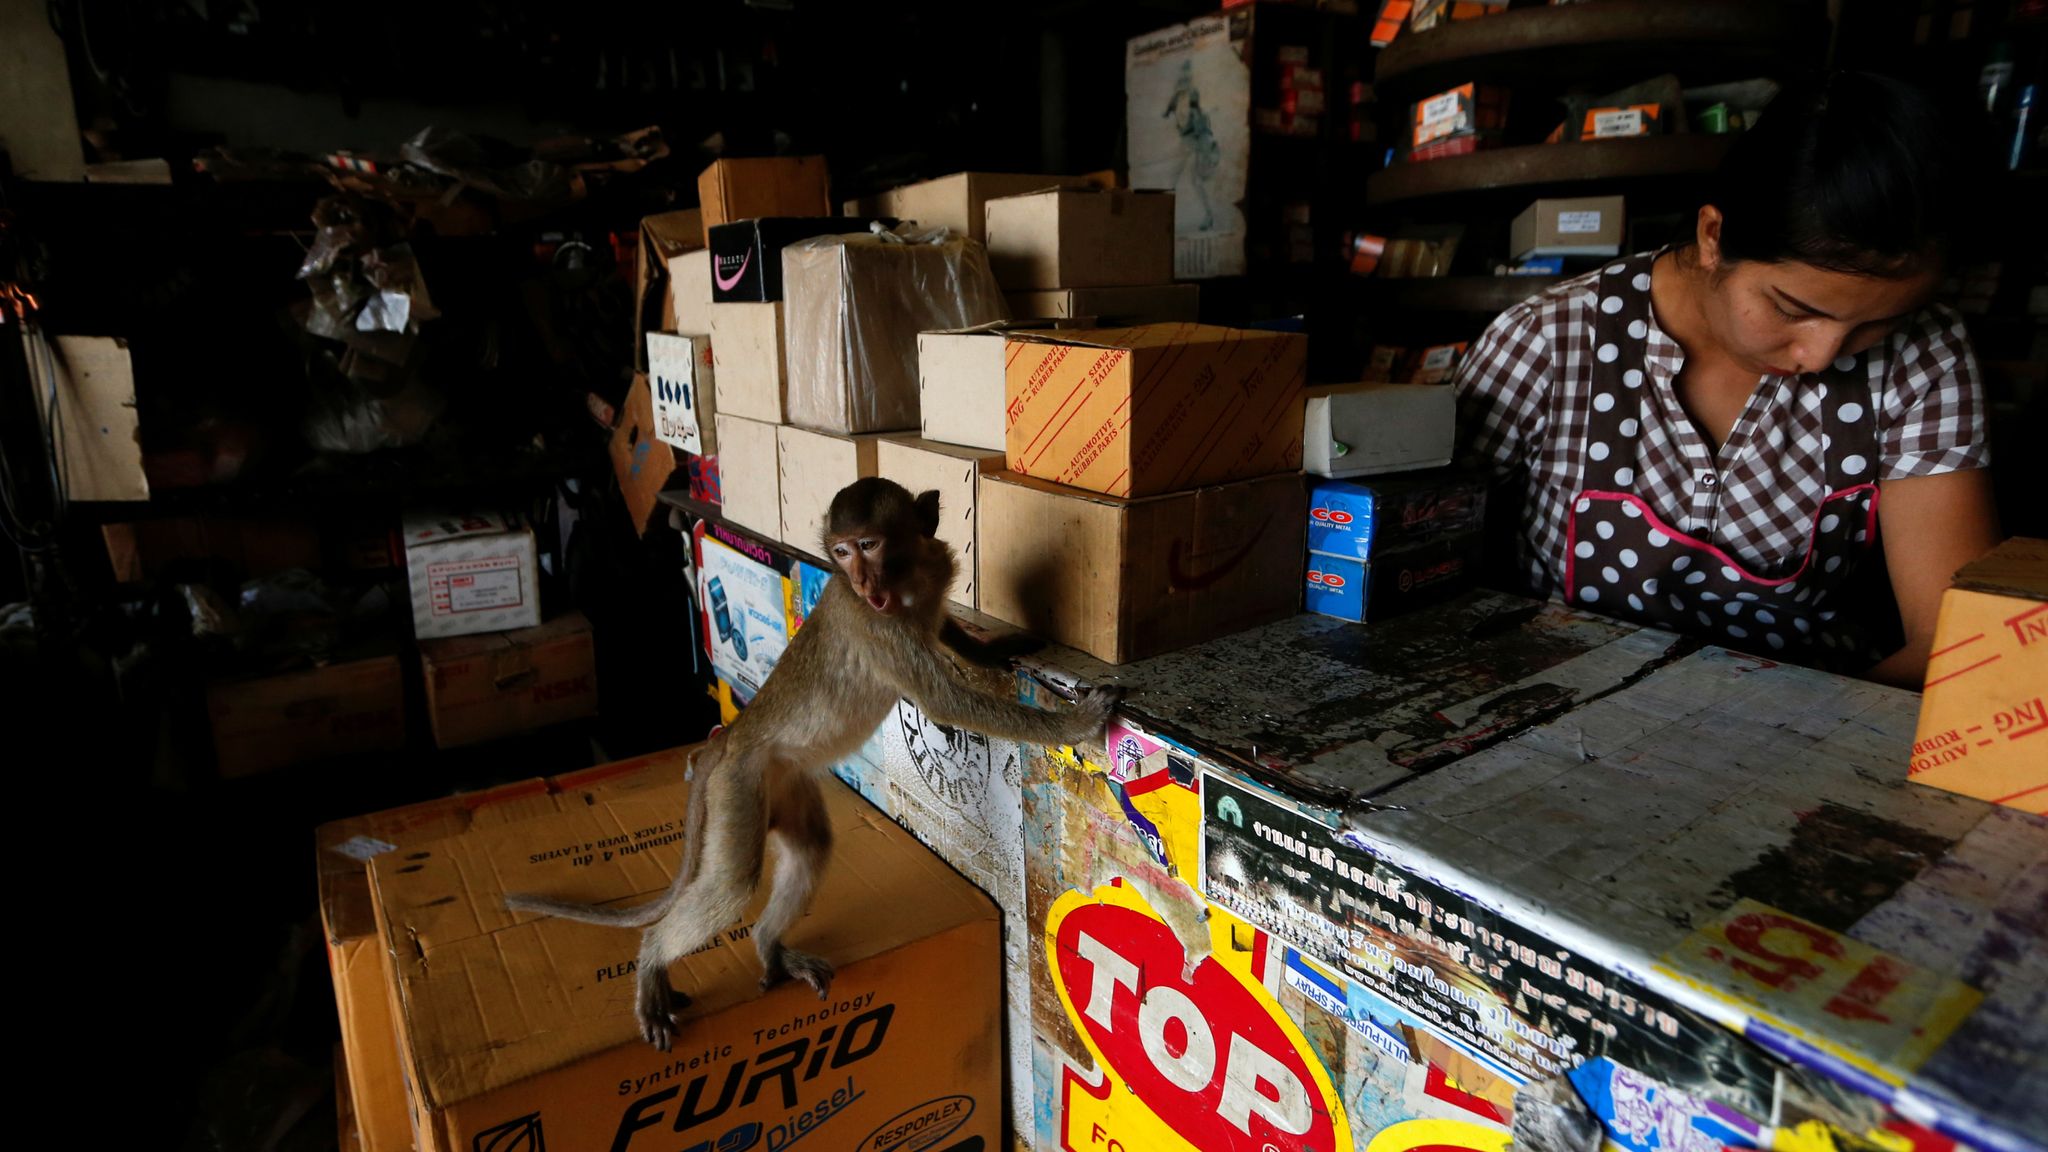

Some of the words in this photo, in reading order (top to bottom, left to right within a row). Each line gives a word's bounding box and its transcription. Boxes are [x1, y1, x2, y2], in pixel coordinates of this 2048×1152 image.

[1088, 351, 1110, 378] PARTS
[1031, 367, 1055, 397] RUBBER
[1070, 418, 1114, 469] AUTOMOTIVE
[1073, 449, 1099, 479] RUBBER
[1098, 428, 1119, 453] PARTS
[1314, 520, 1334, 529] QUALITY
[1335, 523, 1352, 532] METAL
[2004, 603, 2048, 647] TN
[1909, 728, 1961, 757] RUBB
[598, 833, 630, 850] OVER
[633, 822, 674, 842] STACK
[529, 845, 578, 865] LAYERS
[596, 959, 638, 983] PLEA
[1295, 977, 1329, 1007] SPRAY
[618, 1044, 733, 1096] Synthetic
[753, 989, 876, 1046] Technology
[1076, 929, 1314, 1138] TOP
[766, 1076, 854, 1151] Diesel
[873, 1099, 963, 1150] RESPOPLEX
